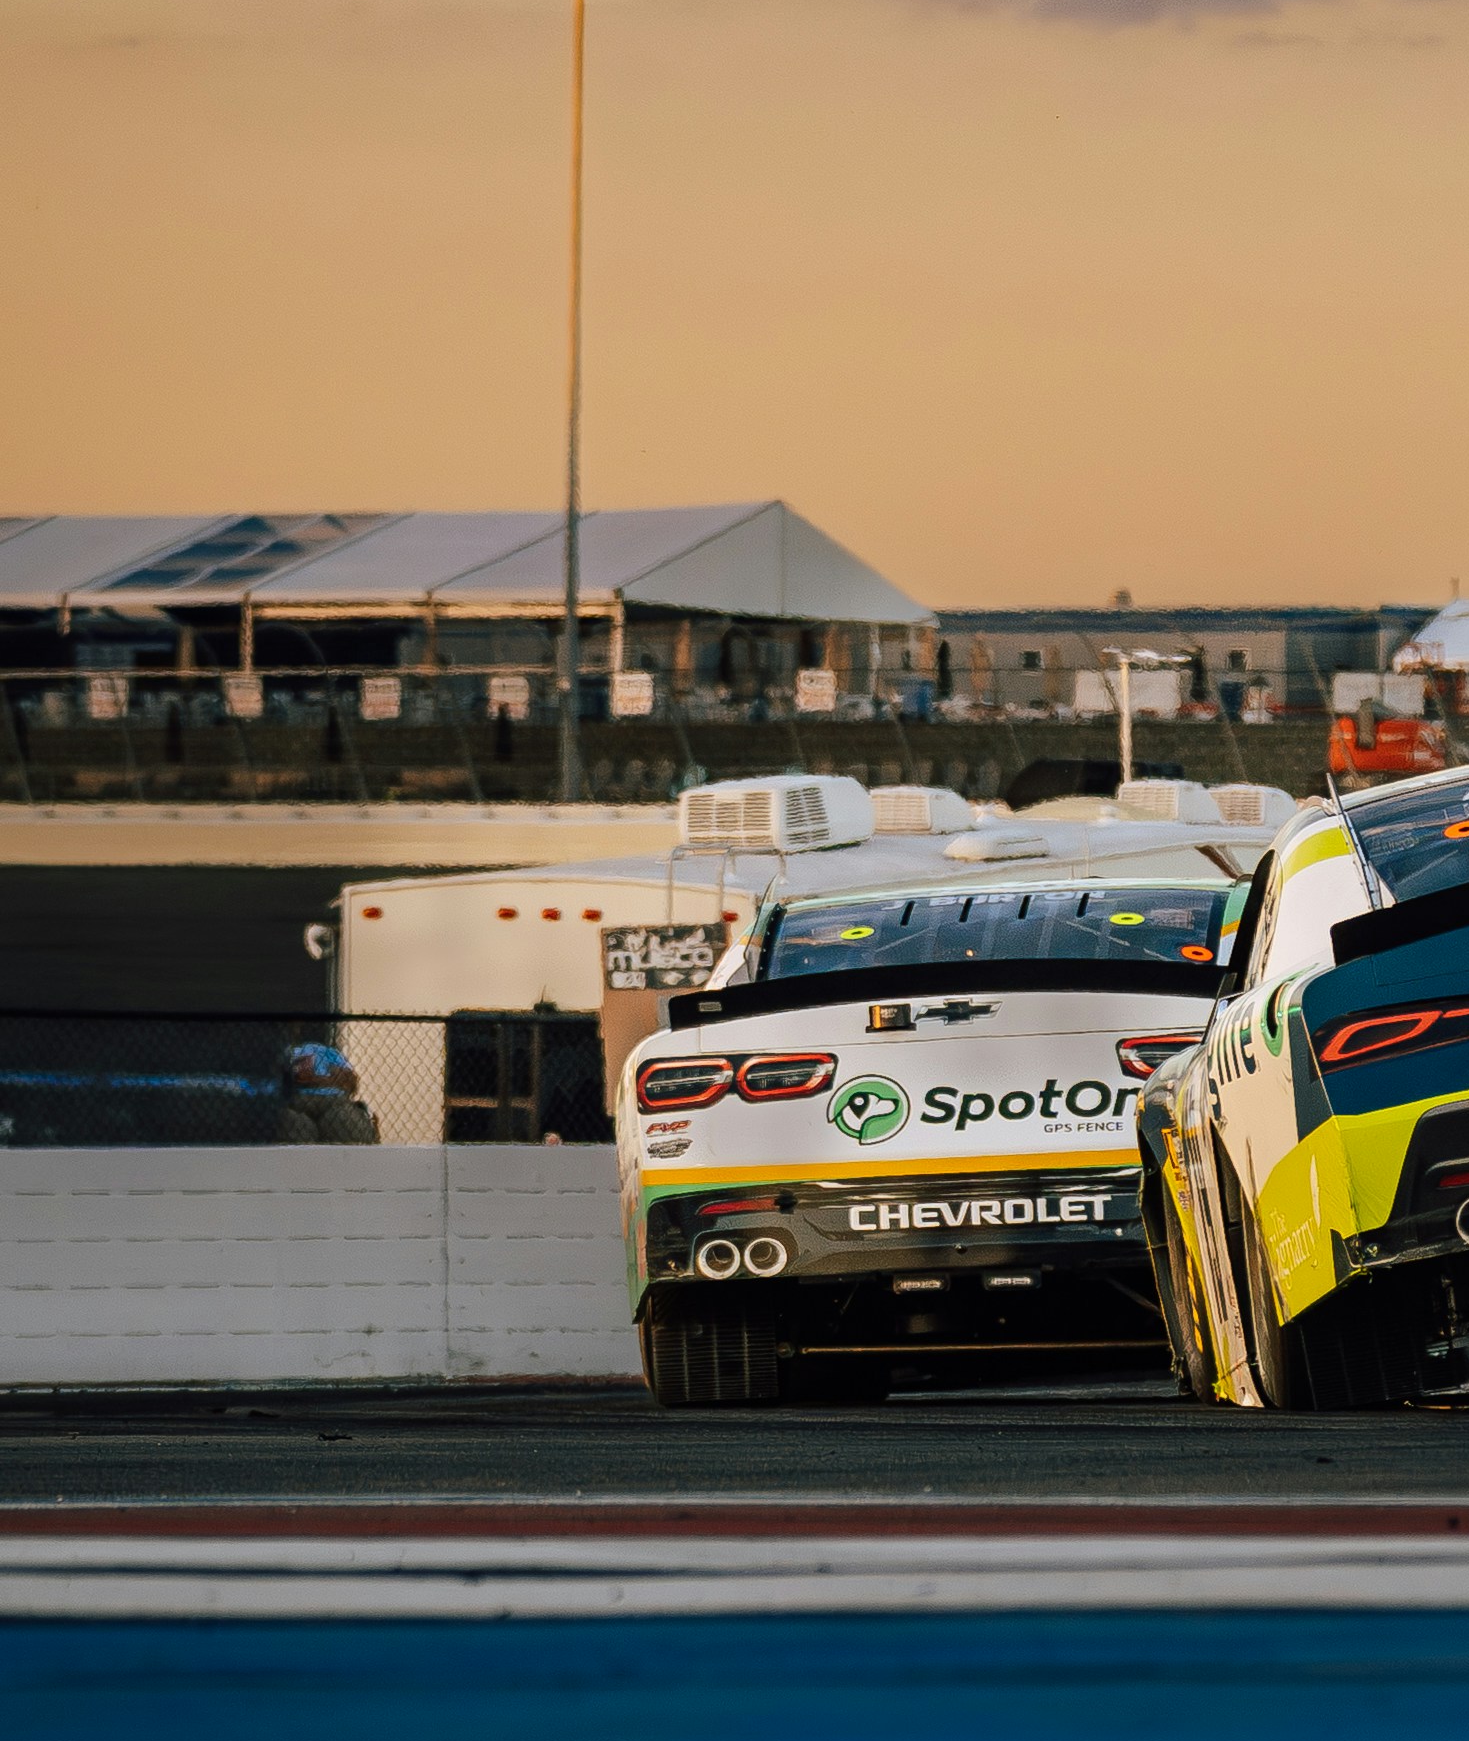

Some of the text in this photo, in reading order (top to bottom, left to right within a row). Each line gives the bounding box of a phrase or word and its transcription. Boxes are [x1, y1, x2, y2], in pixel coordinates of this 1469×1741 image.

[920, 1079, 1143, 1131] SpotOn
[1044, 1121, 1124, 1133] GPS FENCE
[850, 1195, 1112, 1230] CHEVROLET
